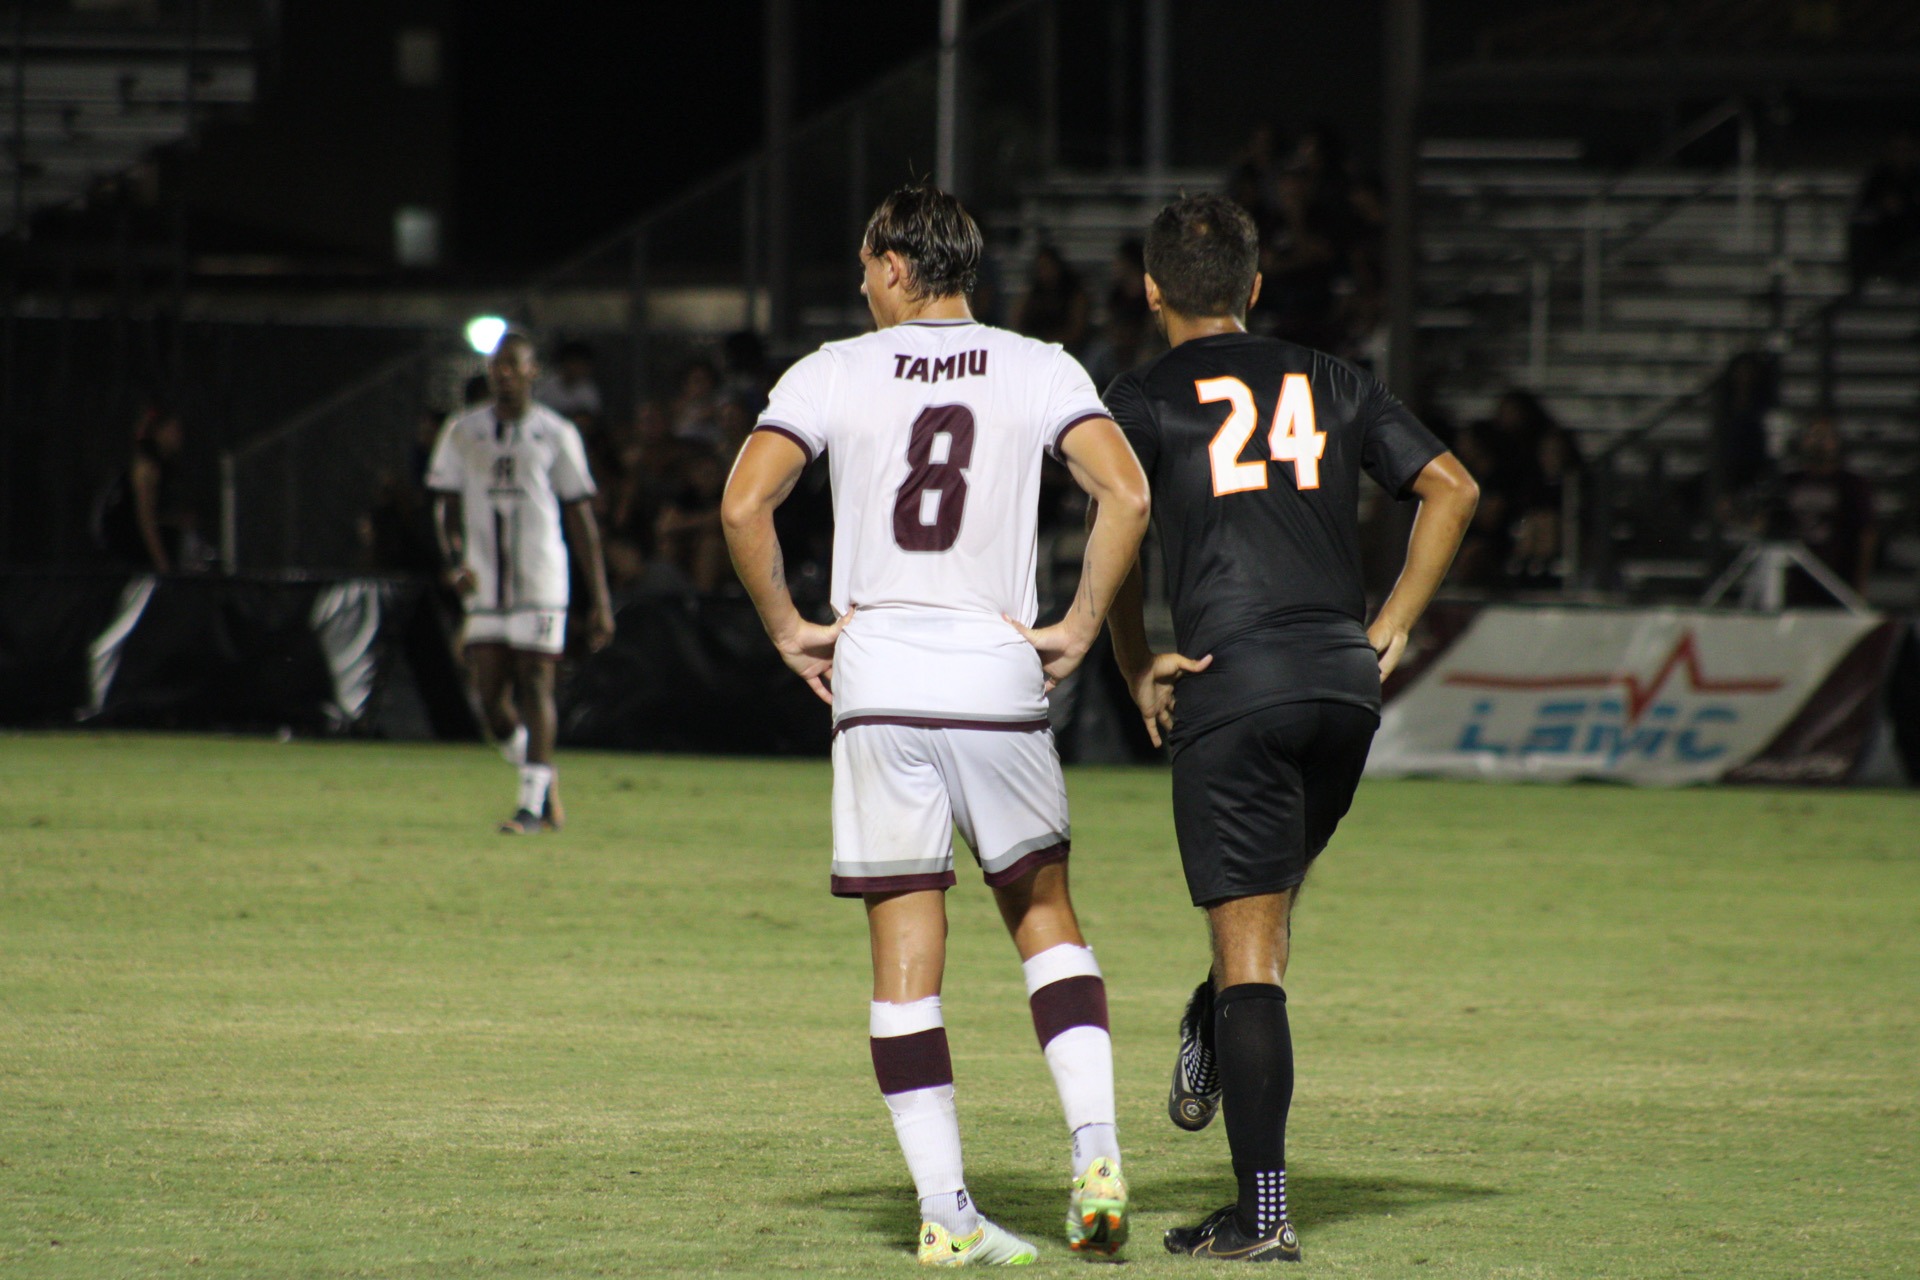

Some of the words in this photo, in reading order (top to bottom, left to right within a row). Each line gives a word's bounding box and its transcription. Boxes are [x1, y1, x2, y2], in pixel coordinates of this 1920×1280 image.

[894, 349, 988, 383] TAMIU
[891, 402, 977, 555] 8
[1195, 373, 1327, 497] 24
